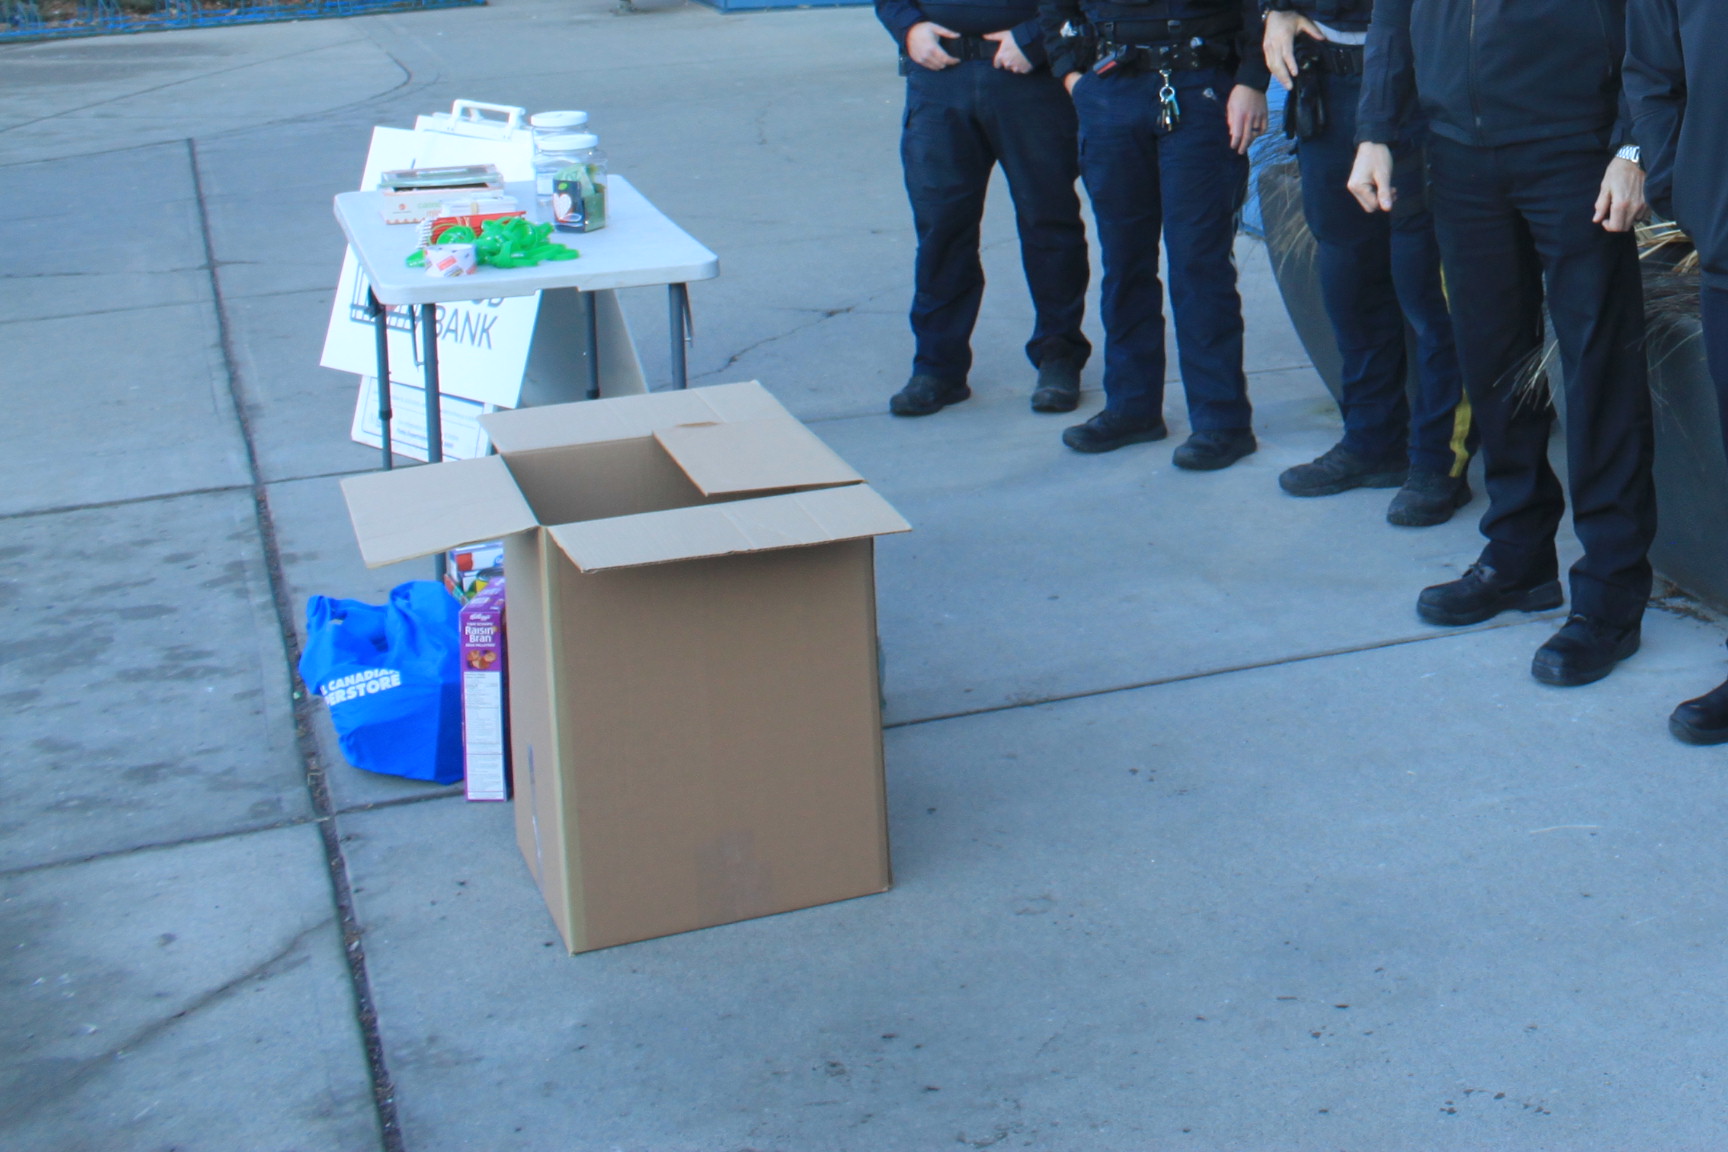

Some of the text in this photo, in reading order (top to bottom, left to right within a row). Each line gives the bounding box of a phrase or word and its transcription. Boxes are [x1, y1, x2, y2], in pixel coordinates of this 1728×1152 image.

[436, 305, 498, 350] BANK
[465, 626, 494, 635] Raisin
[469, 635, 492, 643] Bran
[325, 674, 402, 706] ERSTORE
